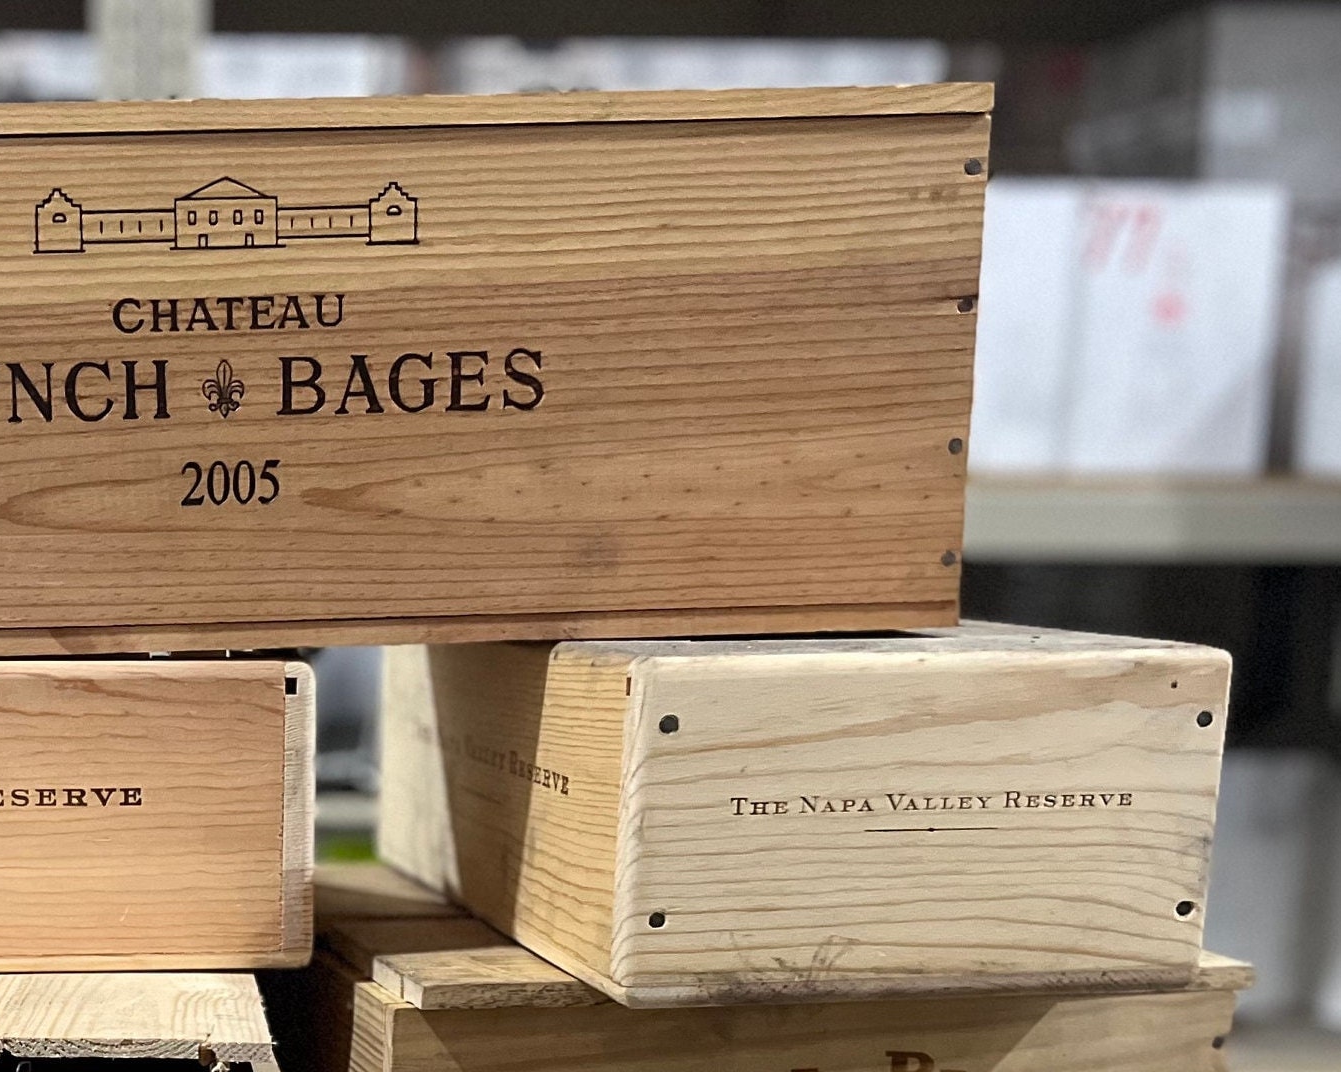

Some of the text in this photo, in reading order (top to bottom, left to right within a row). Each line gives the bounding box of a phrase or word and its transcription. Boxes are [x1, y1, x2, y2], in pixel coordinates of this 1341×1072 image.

[112, 294, 346, 334] CHATEAU
[275, 347, 546, 416] BAGES
[180, 459, 282, 507] 2005
[731, 790, 1133, 815] THE NAPA VALLEY RESERVE
